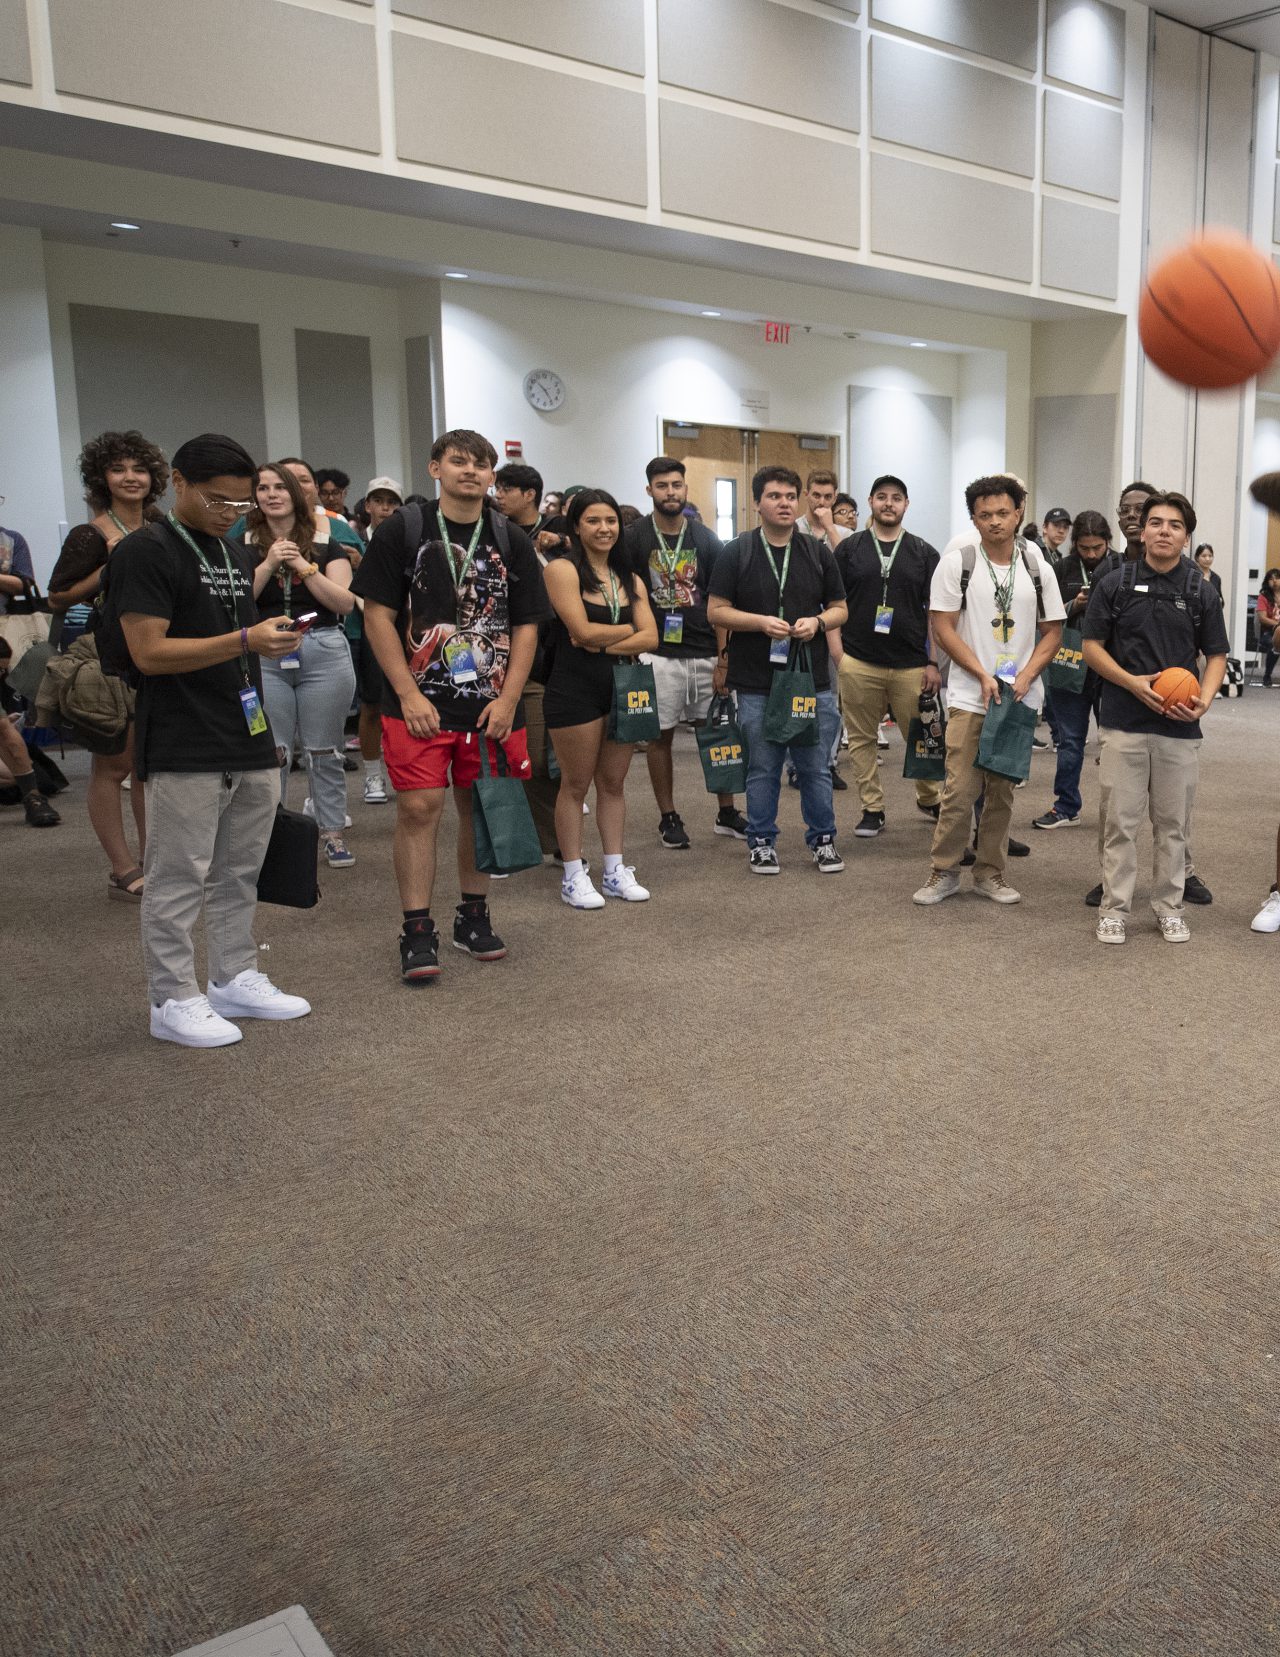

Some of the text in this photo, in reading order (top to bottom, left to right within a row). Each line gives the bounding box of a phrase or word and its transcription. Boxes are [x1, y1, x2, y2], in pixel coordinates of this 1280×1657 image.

[765, 320, 791, 345] EXIT
[1055, 647, 1083, 665] CPP
[709, 744, 742, 762] CPP
